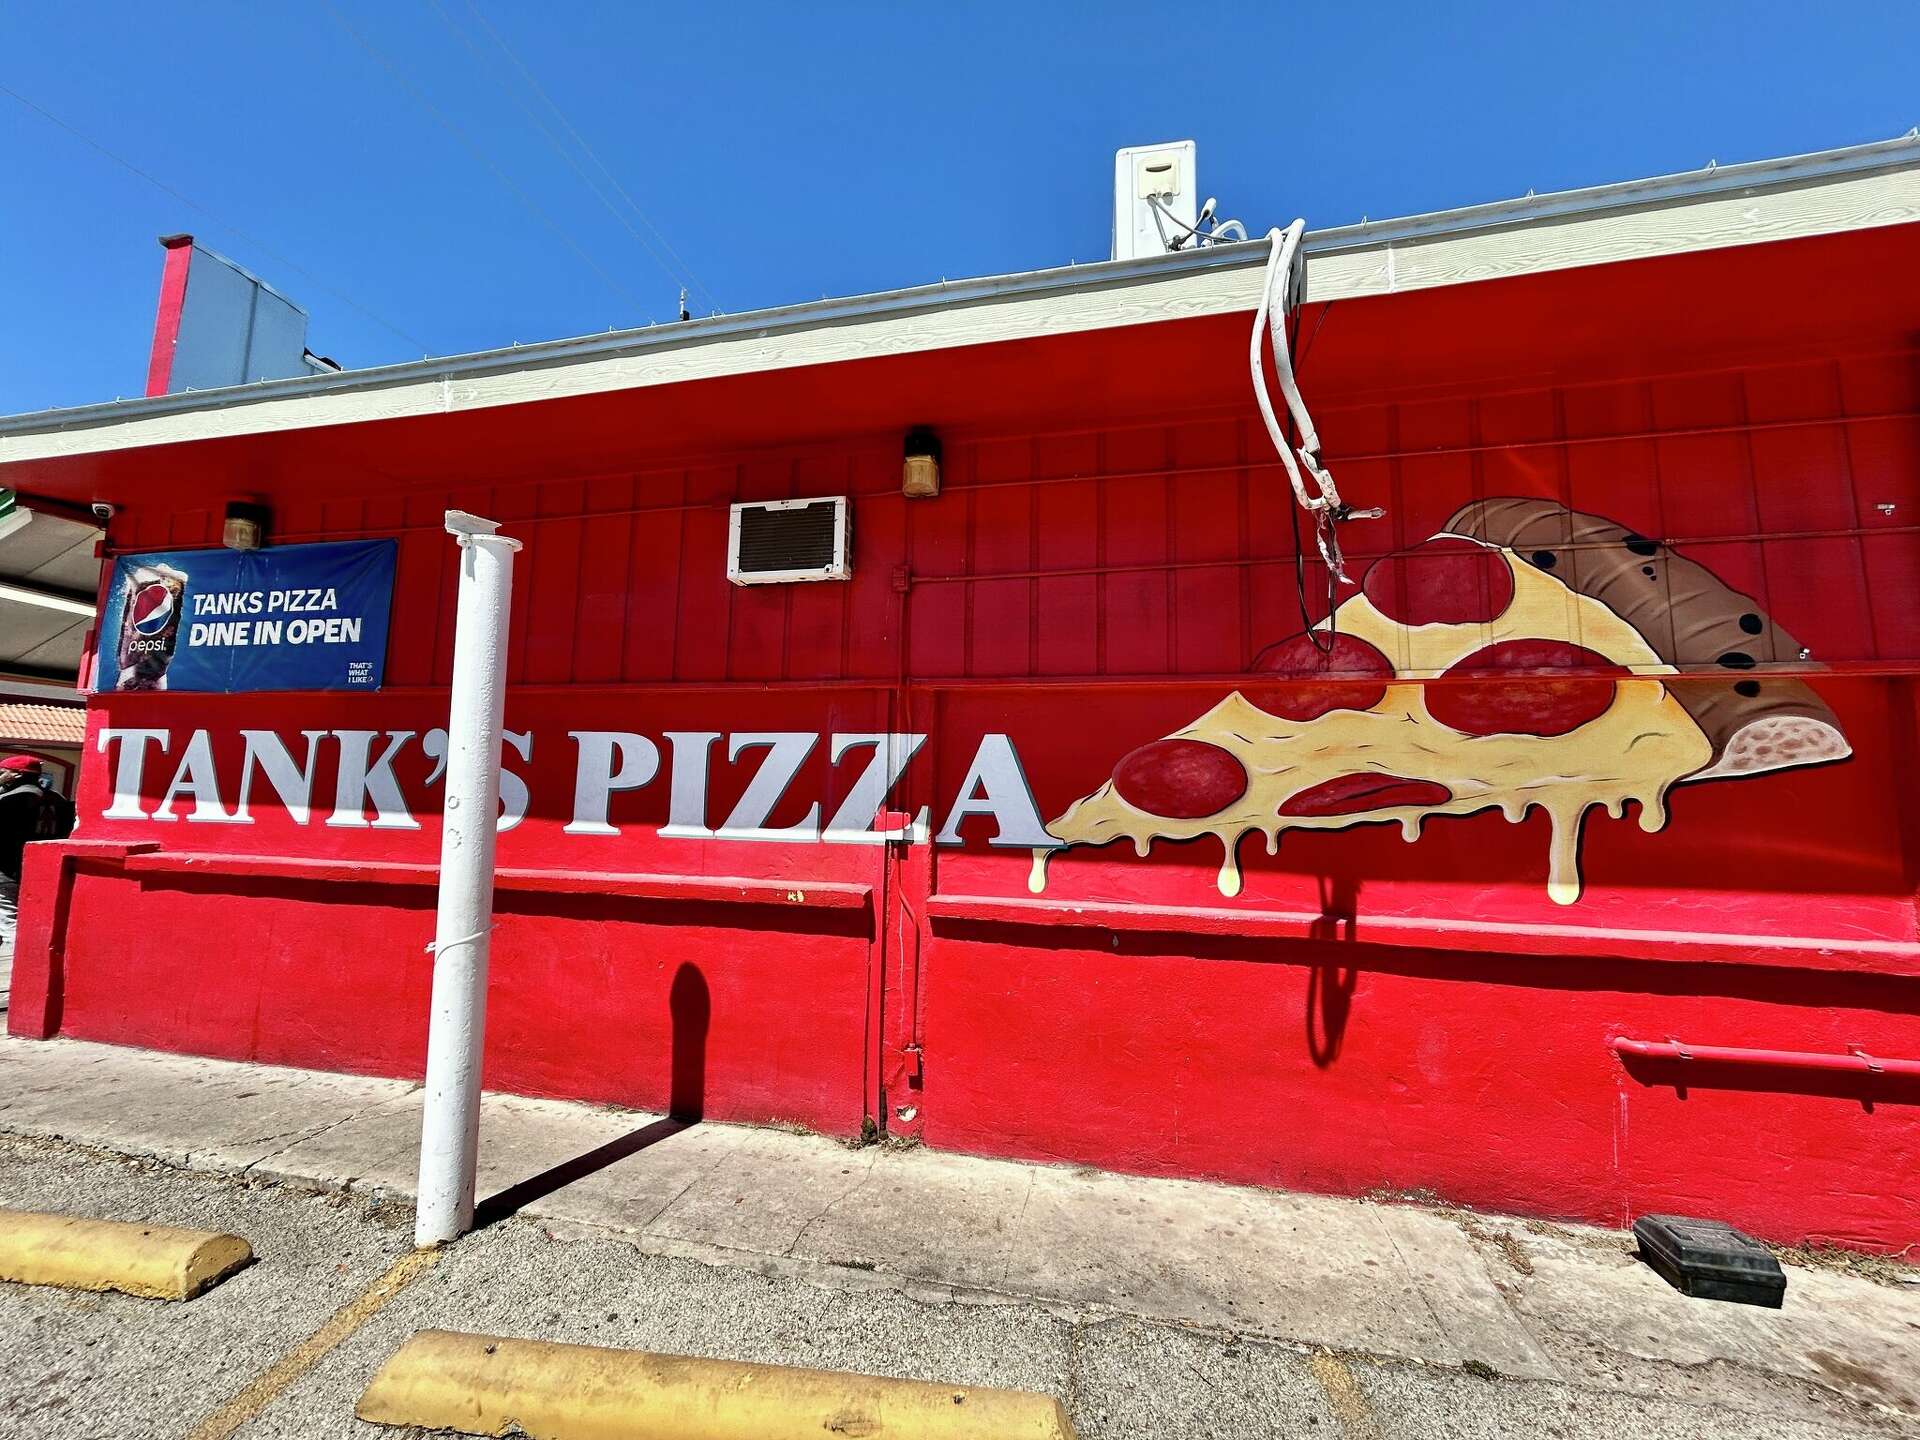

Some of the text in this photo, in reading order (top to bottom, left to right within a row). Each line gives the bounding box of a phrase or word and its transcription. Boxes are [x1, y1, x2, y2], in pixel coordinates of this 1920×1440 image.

[193, 588, 338, 616] TANKS PIZZA
[188, 617, 362, 647] DINE IN OPEN
[127, 636, 166, 655] pepsi
[348, 662, 374, 670] THAT'S
[348, 669, 369, 677] WHAT
[351, 676, 368, 684] LIKE
[562, 730, 1068, 850] PIZZA
